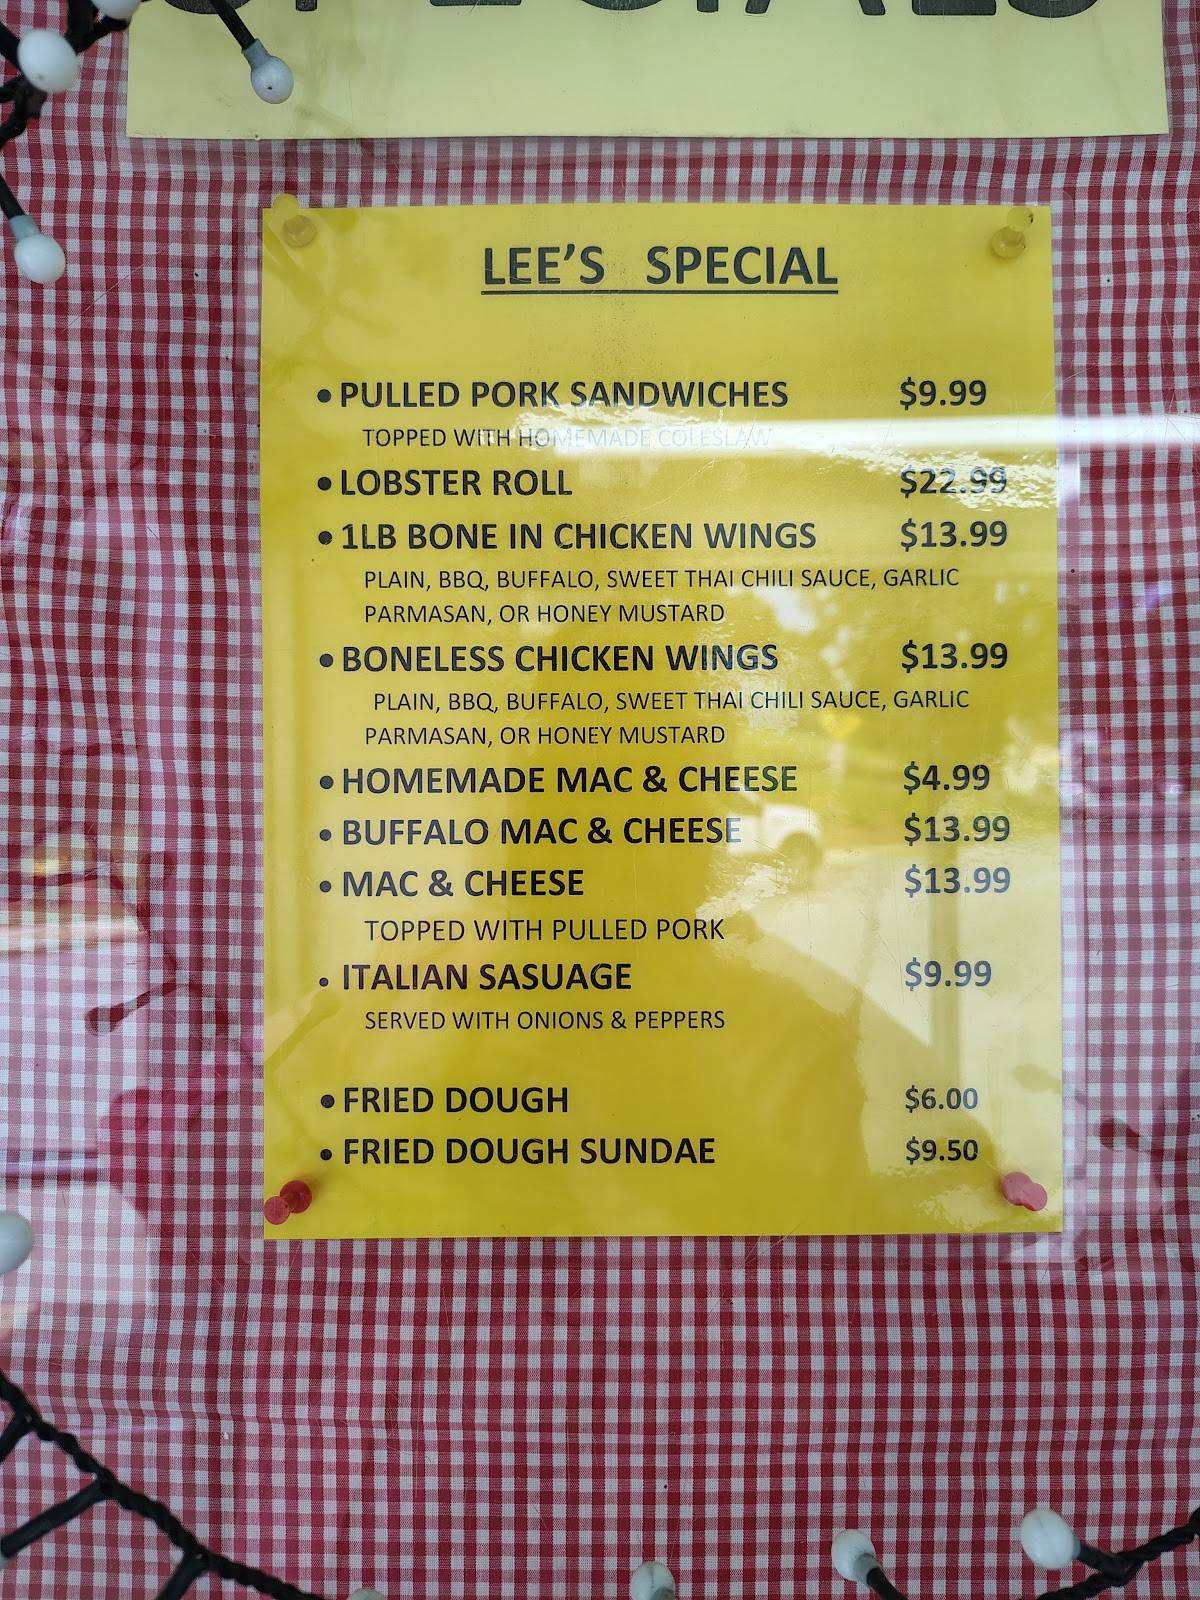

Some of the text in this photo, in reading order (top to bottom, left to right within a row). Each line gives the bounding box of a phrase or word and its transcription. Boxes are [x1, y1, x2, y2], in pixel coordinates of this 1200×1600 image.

[647, 246, 838, 284] SPECIAL
[341, 381, 788, 408] PULLED PORK SANDWICHES
[900, 377, 986, 411] $9.99
[362, 426, 772, 447] TOPPED WITH HOMEMADE COLESLAW
[342, 470, 572, 496] LOBSTER ROLL
[901, 465, 1007, 498] $22.99
[342, 522, 816, 549] 1LB BONE IN CHICKEN WINGS
[901, 518, 1007, 552] $13.99
[366, 568, 959, 592] PLAIN, BBQ, BUFFALO, SWEET THAI CHILI SAUCE, GARLIC
[366, 604, 724, 626] PARMASAN, OR HONEY MUSTARD
[343, 644, 778, 672] BONELESS CHICKEN WINGS
[902, 640, 1007, 673] $13.99
[375, 690, 969, 714] PLAIN, BBQ, BUFFALO, SWEET THAI CHILI SAUCE, GARLIC
[366, 726, 725, 748] PARMASAN, OR HONEY MUSTARD
[343, 766, 797, 793] HOMEMADE MAC & CHEESE
[904, 761, 990, 795] $4.99
[344, 817, 741, 845] BUFFALO MAC & CHEESE
[904, 812, 1010, 846] $13.99
[344, 870, 583, 897] MAC & CHEESE
[905, 864, 1010, 898] $13.99
[364, 919, 724, 941] TOPPED WITH PULLED PORK
[344, 963, 631, 990] ITALIAN SASUAGE
[905, 957, 991, 991] $9.99
[365, 1011, 724, 1029] SERVED WITH ONIONS & PEPPERS
[345, 1087, 567, 1113] FRIED DOUGH
[906, 1085, 978, 1113] $6.00
[345, 1138, 715, 1164] FRIED DOUGH SUNDAE
[906, 1136, 978, 1165] $9.50
